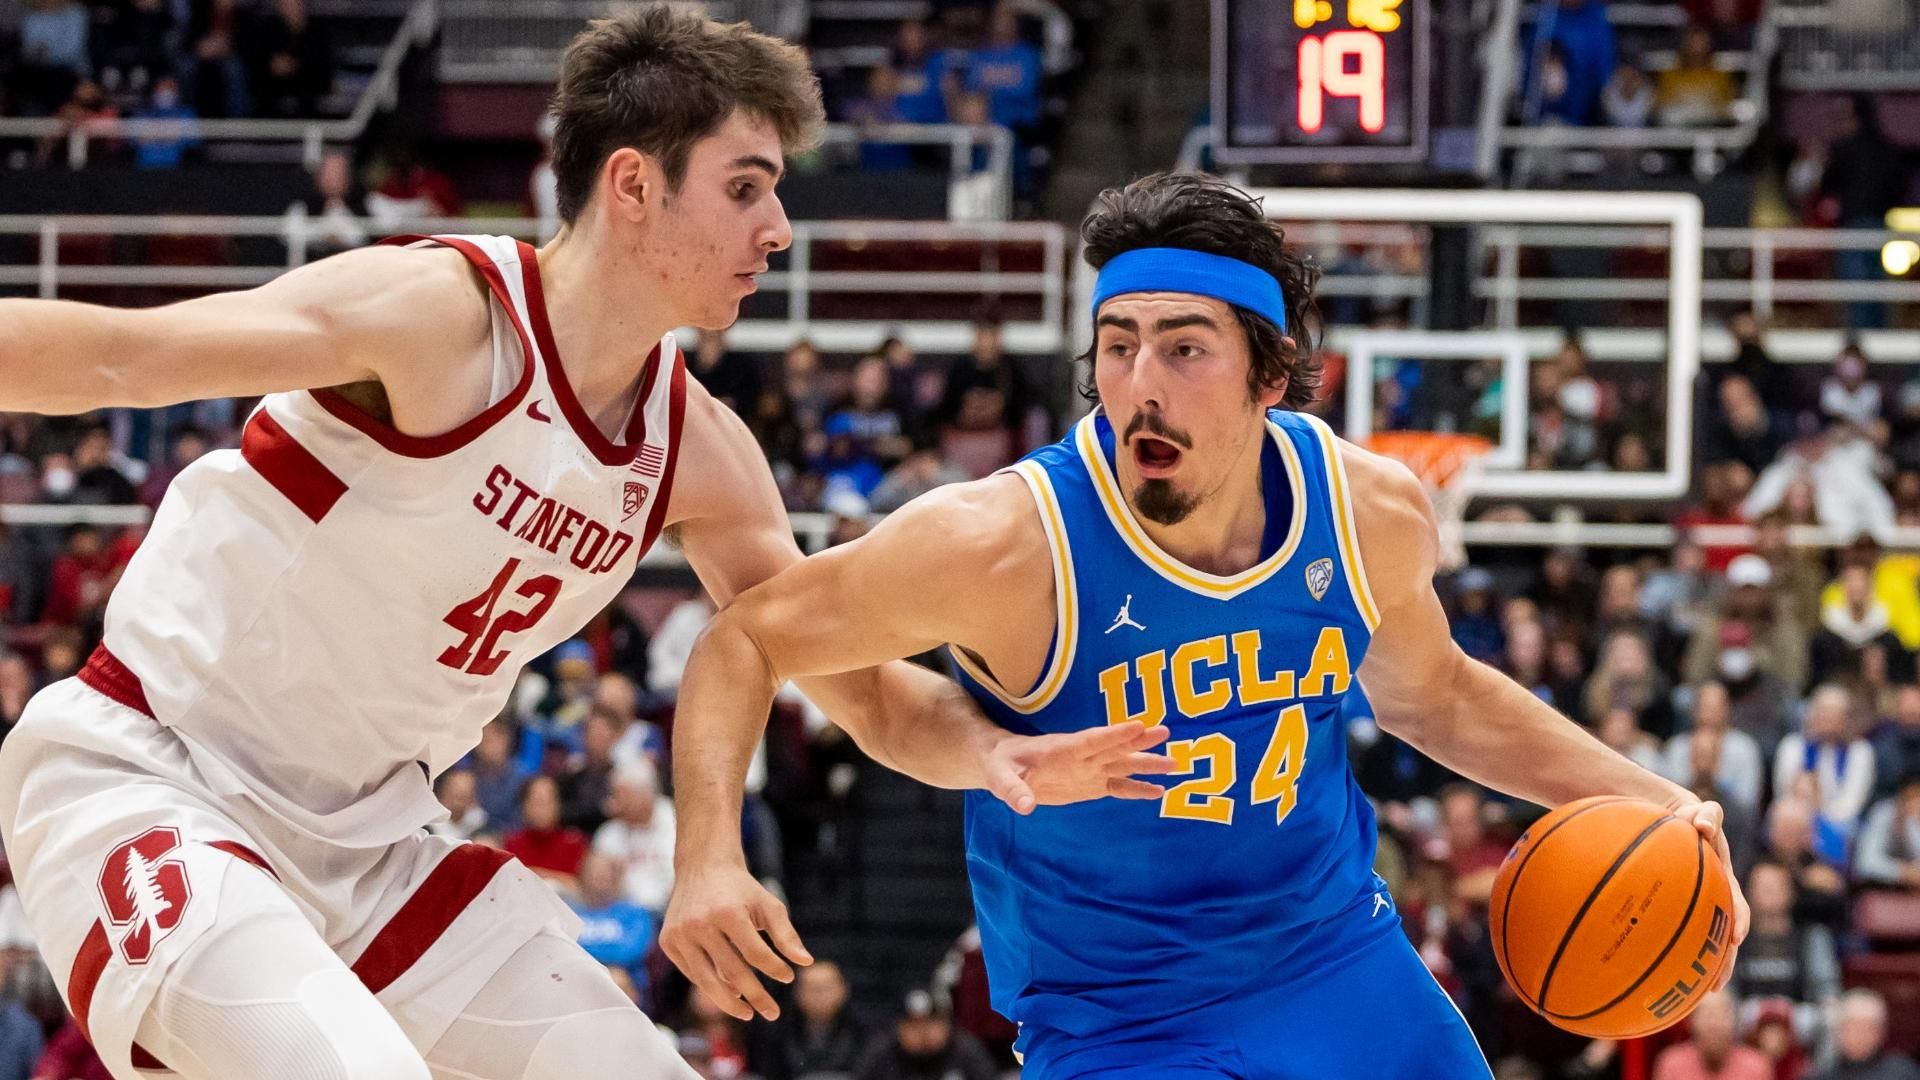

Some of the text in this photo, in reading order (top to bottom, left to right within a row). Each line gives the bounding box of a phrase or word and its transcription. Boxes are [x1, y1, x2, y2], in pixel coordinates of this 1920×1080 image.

[1297, 29, 1386, 134] 19
[436, 557, 563, 677] 42
[1314, 577, 1327, 593] 12
[1099, 626, 1352, 729] UCLA
[1160, 704, 1307, 826] 24
[1647, 905, 1729, 1019] ELITE
